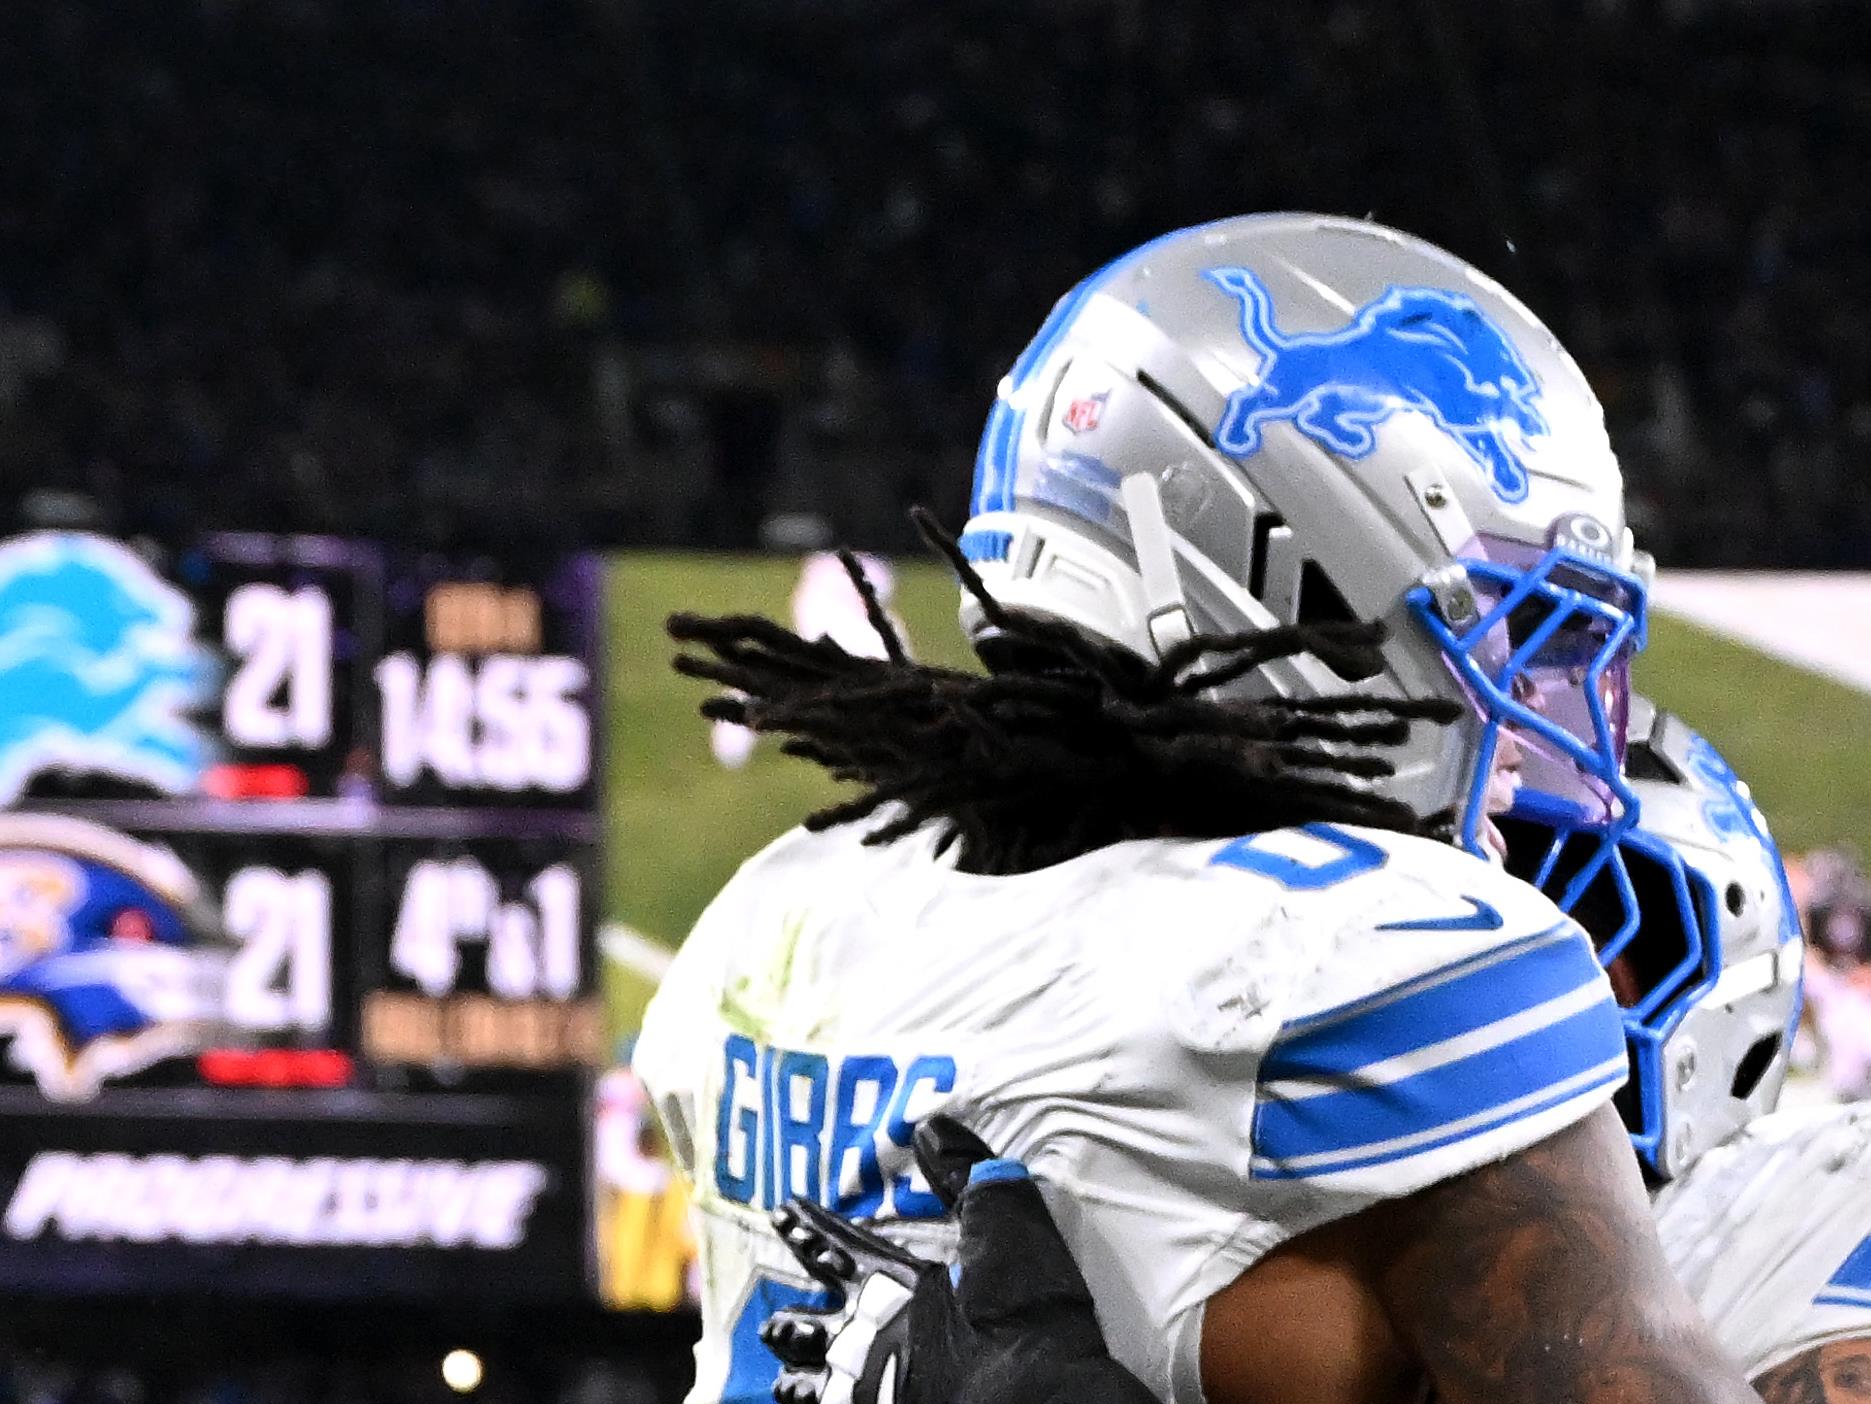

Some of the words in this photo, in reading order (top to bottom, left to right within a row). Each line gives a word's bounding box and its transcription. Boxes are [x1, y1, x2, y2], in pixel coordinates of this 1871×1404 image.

[224, 584, 333, 749] 21
[224, 866, 333, 1031] 21
[714, 1032, 958, 1220] GIBBS
